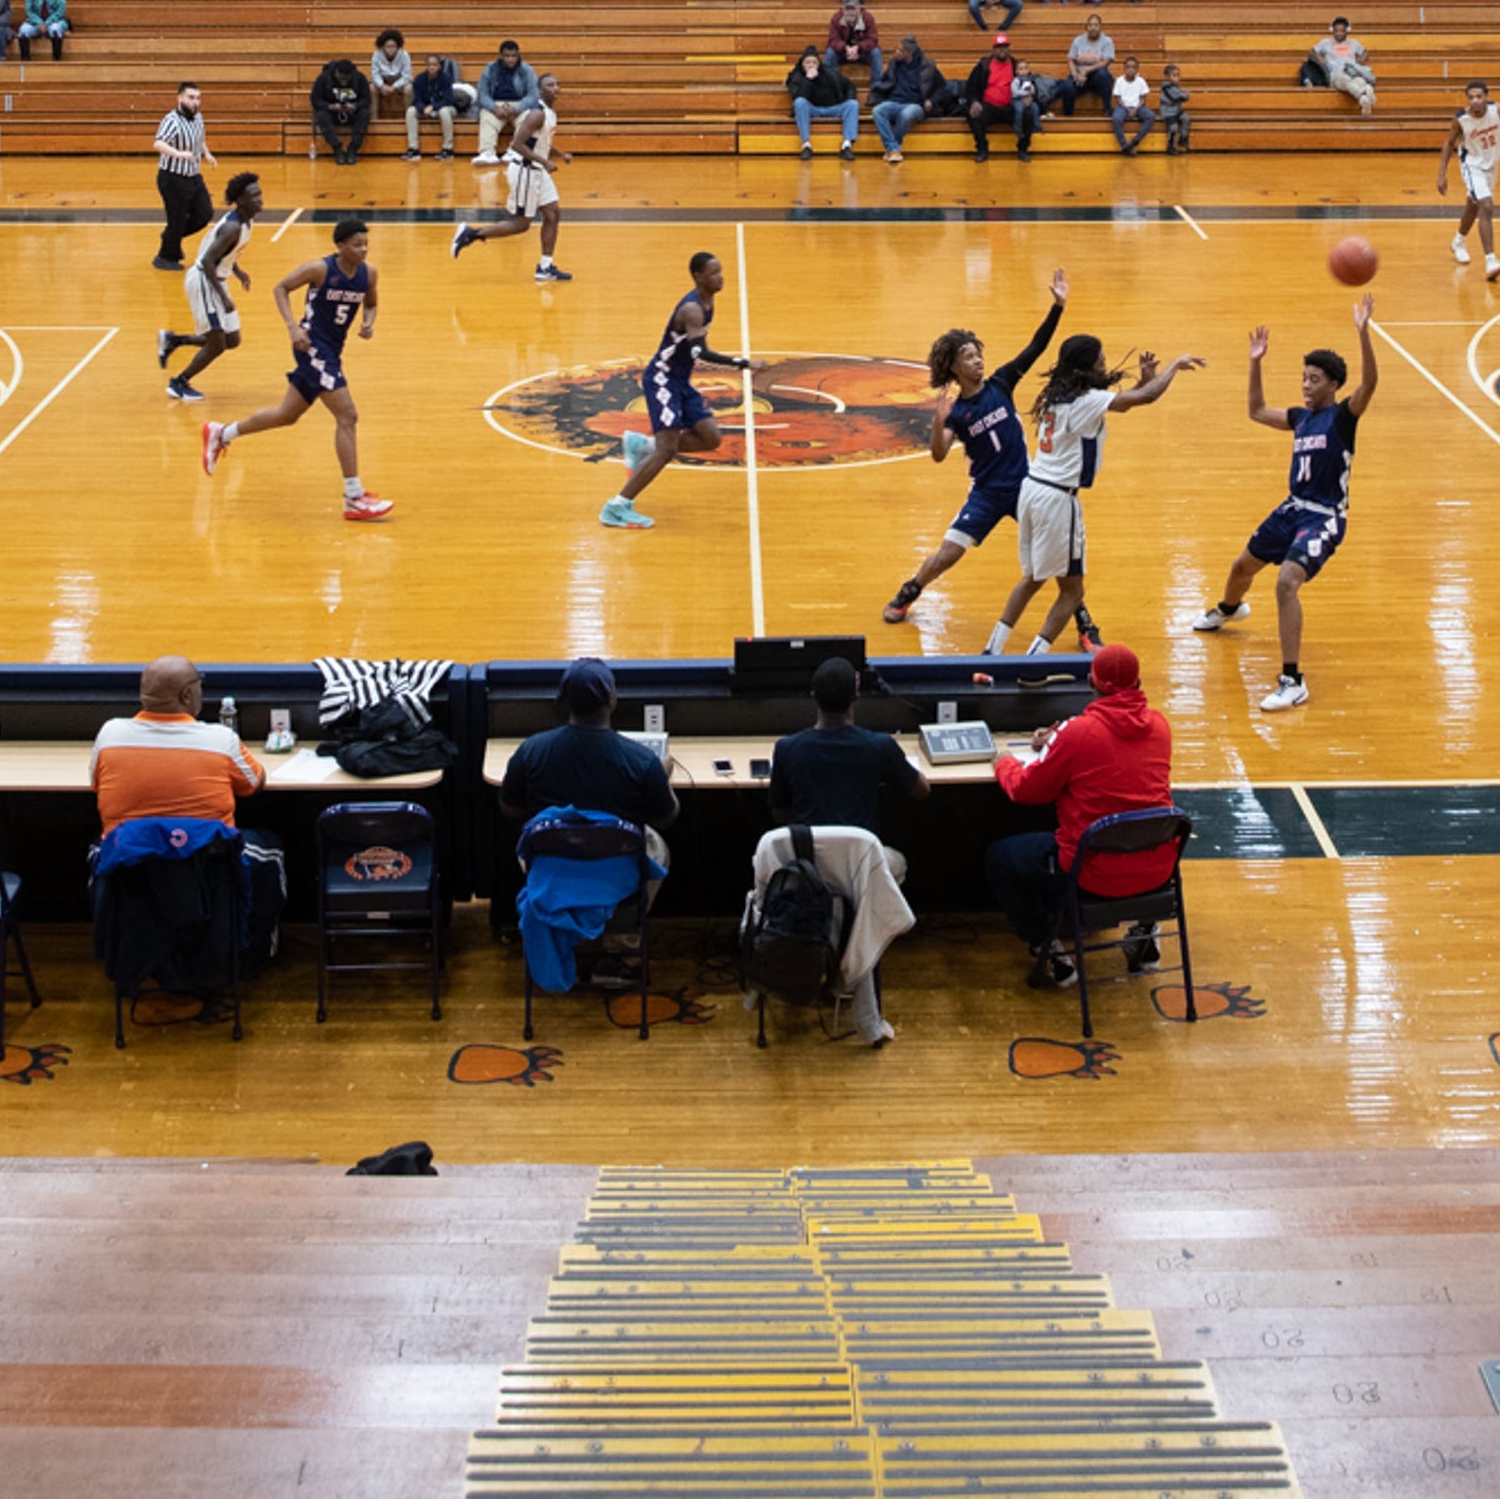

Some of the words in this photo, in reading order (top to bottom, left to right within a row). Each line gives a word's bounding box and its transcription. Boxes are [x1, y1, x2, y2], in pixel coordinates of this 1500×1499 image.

[334, 304, 350, 325] 5
[988, 429, 1002, 452] 1
[1041, 412, 1057, 453] 3
